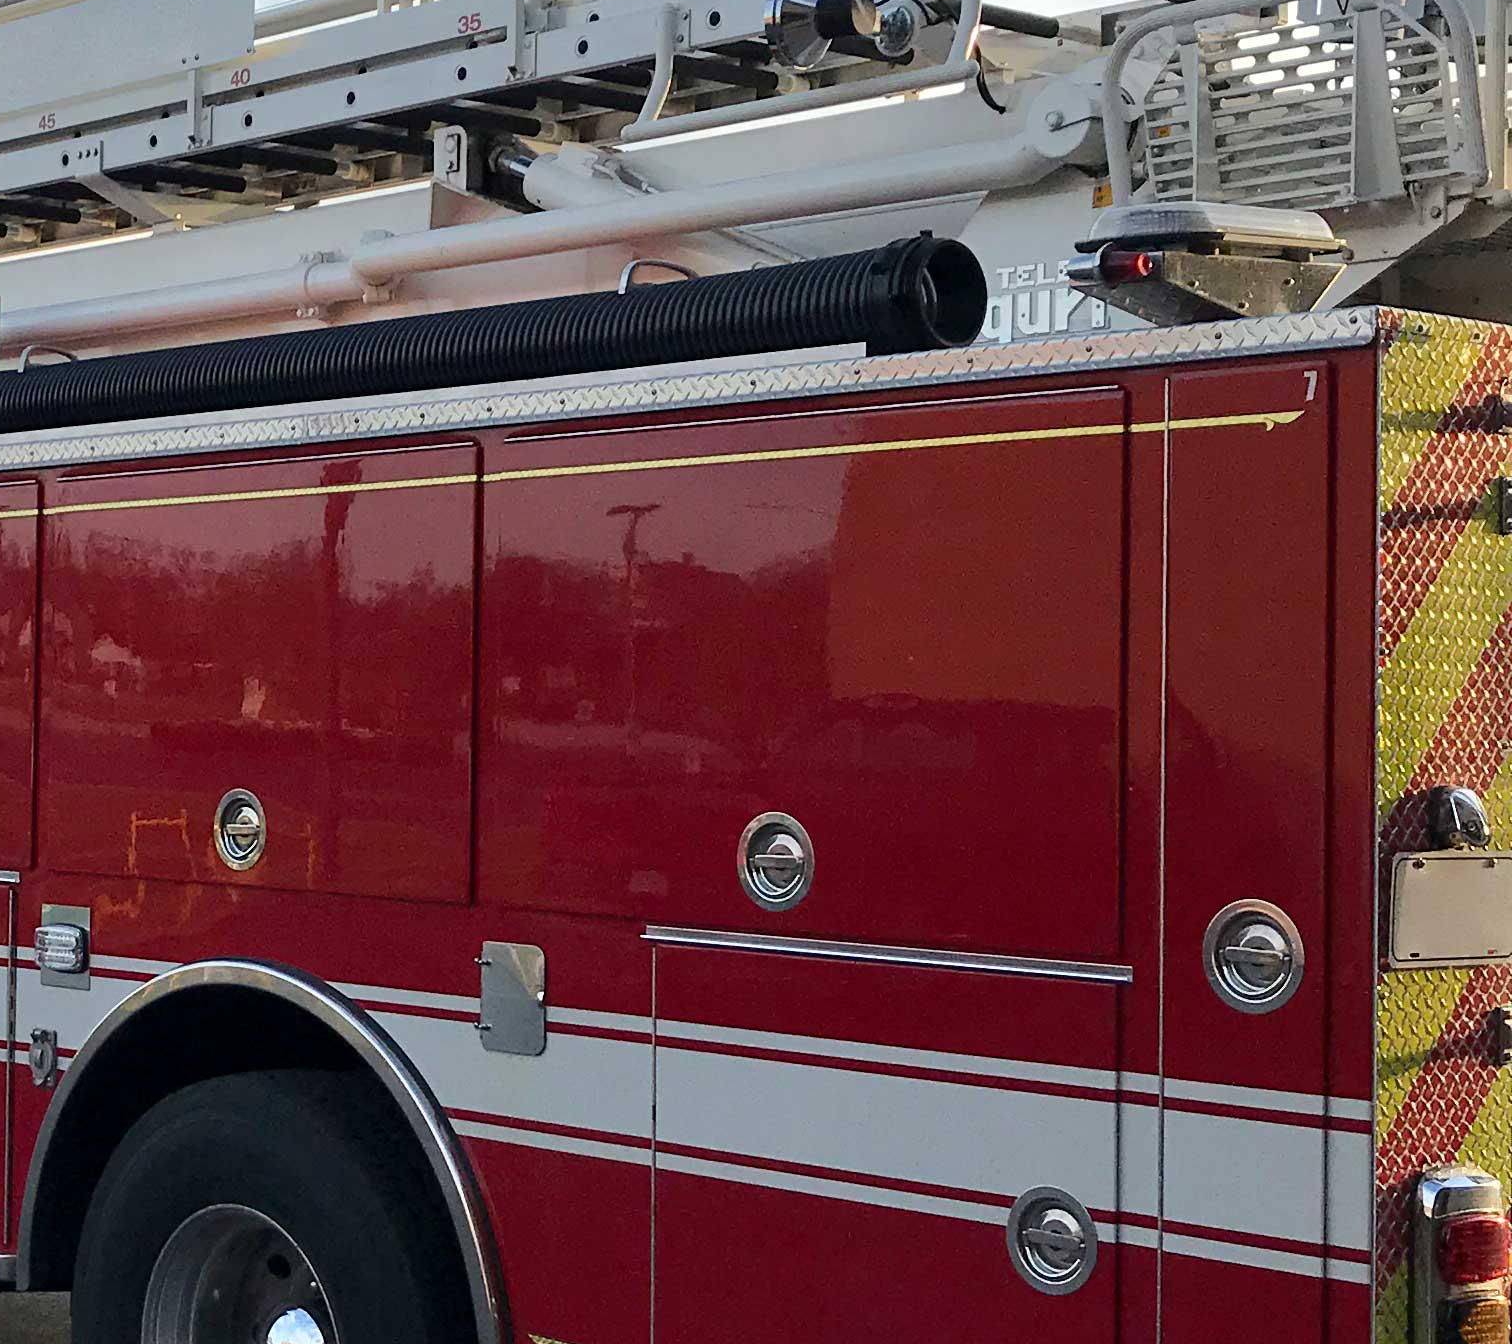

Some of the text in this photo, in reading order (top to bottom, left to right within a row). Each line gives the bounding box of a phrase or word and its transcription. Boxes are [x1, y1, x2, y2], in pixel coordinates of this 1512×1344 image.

[458, 12, 481, 34] 35
[231, 68, 250, 86] 40
[39, 113, 55, 130] 45
[1303, 370, 1318, 401] 7
